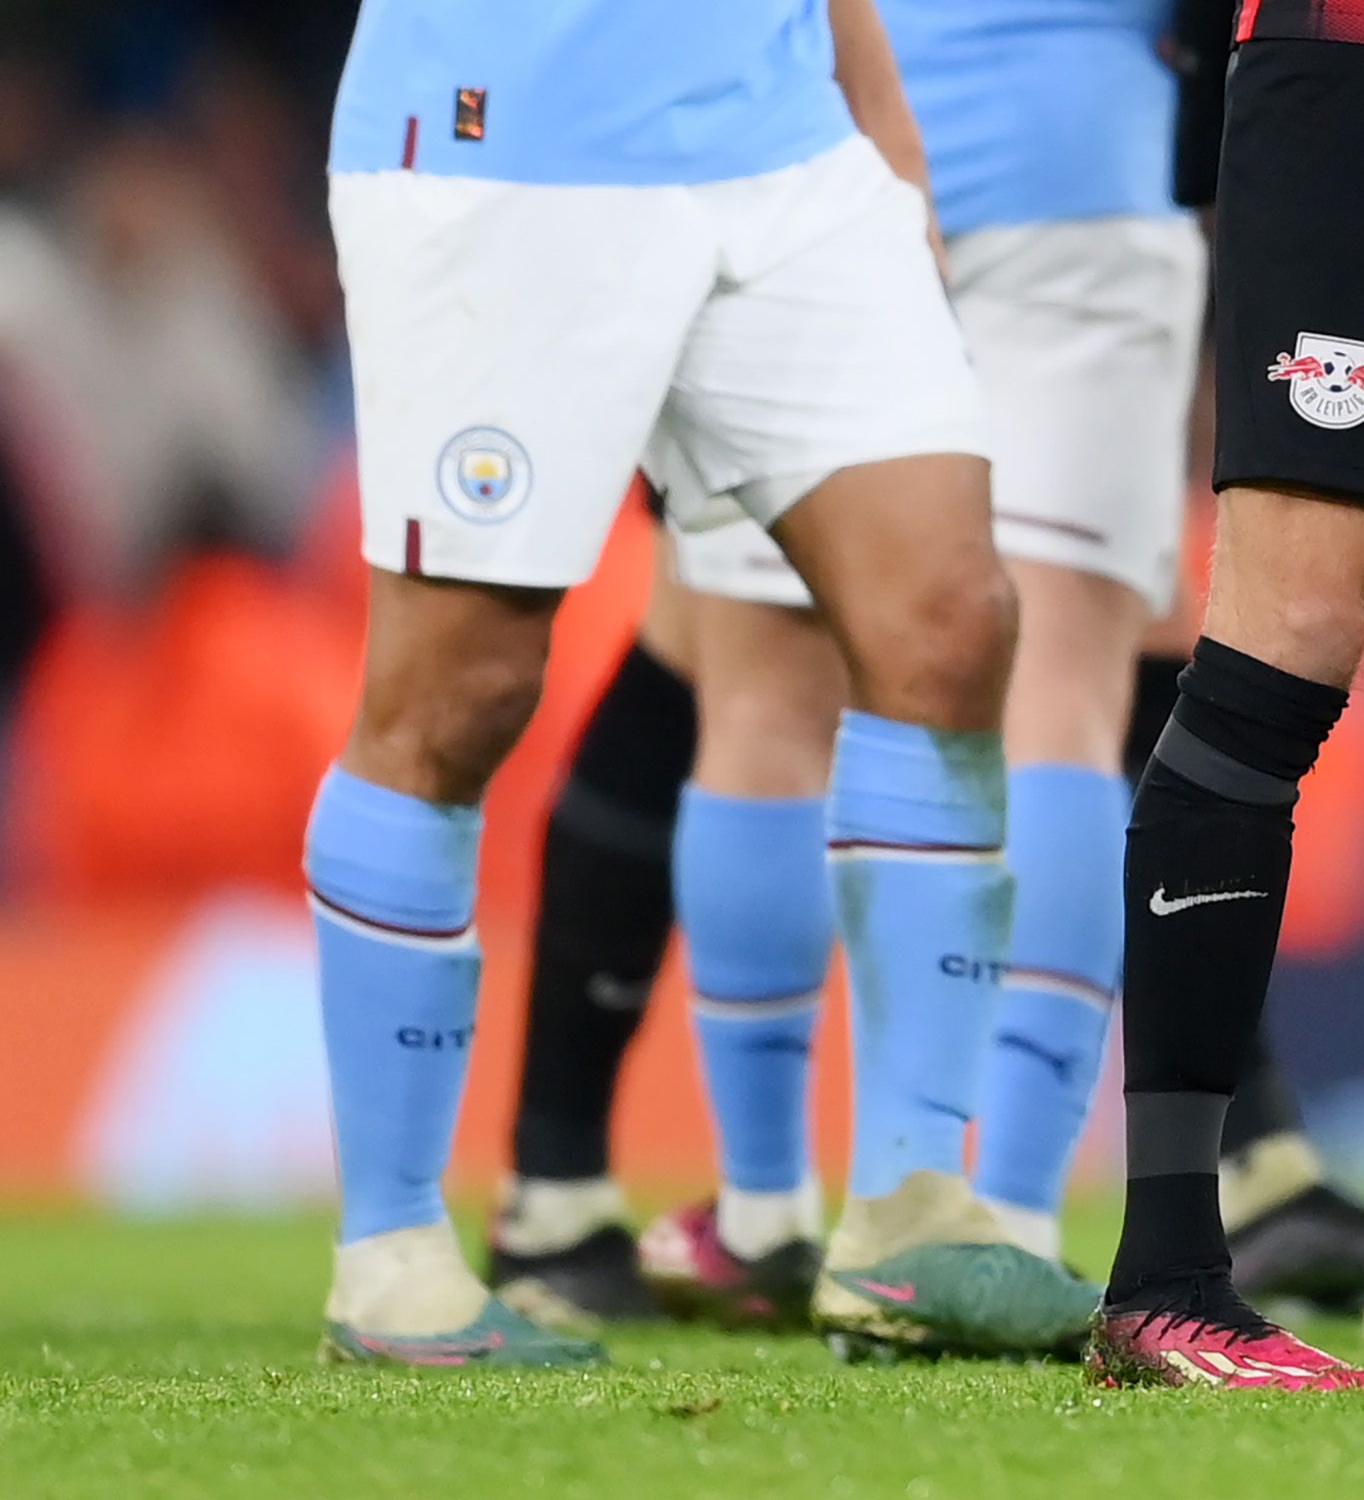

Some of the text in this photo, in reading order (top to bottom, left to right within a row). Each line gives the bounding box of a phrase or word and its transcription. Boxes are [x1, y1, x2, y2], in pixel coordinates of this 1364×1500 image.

[1316, 393, 1364, 417] LEIPZIG
[940, 954, 1013, 985] CIT
[397, 1023, 476, 1050] CIT
